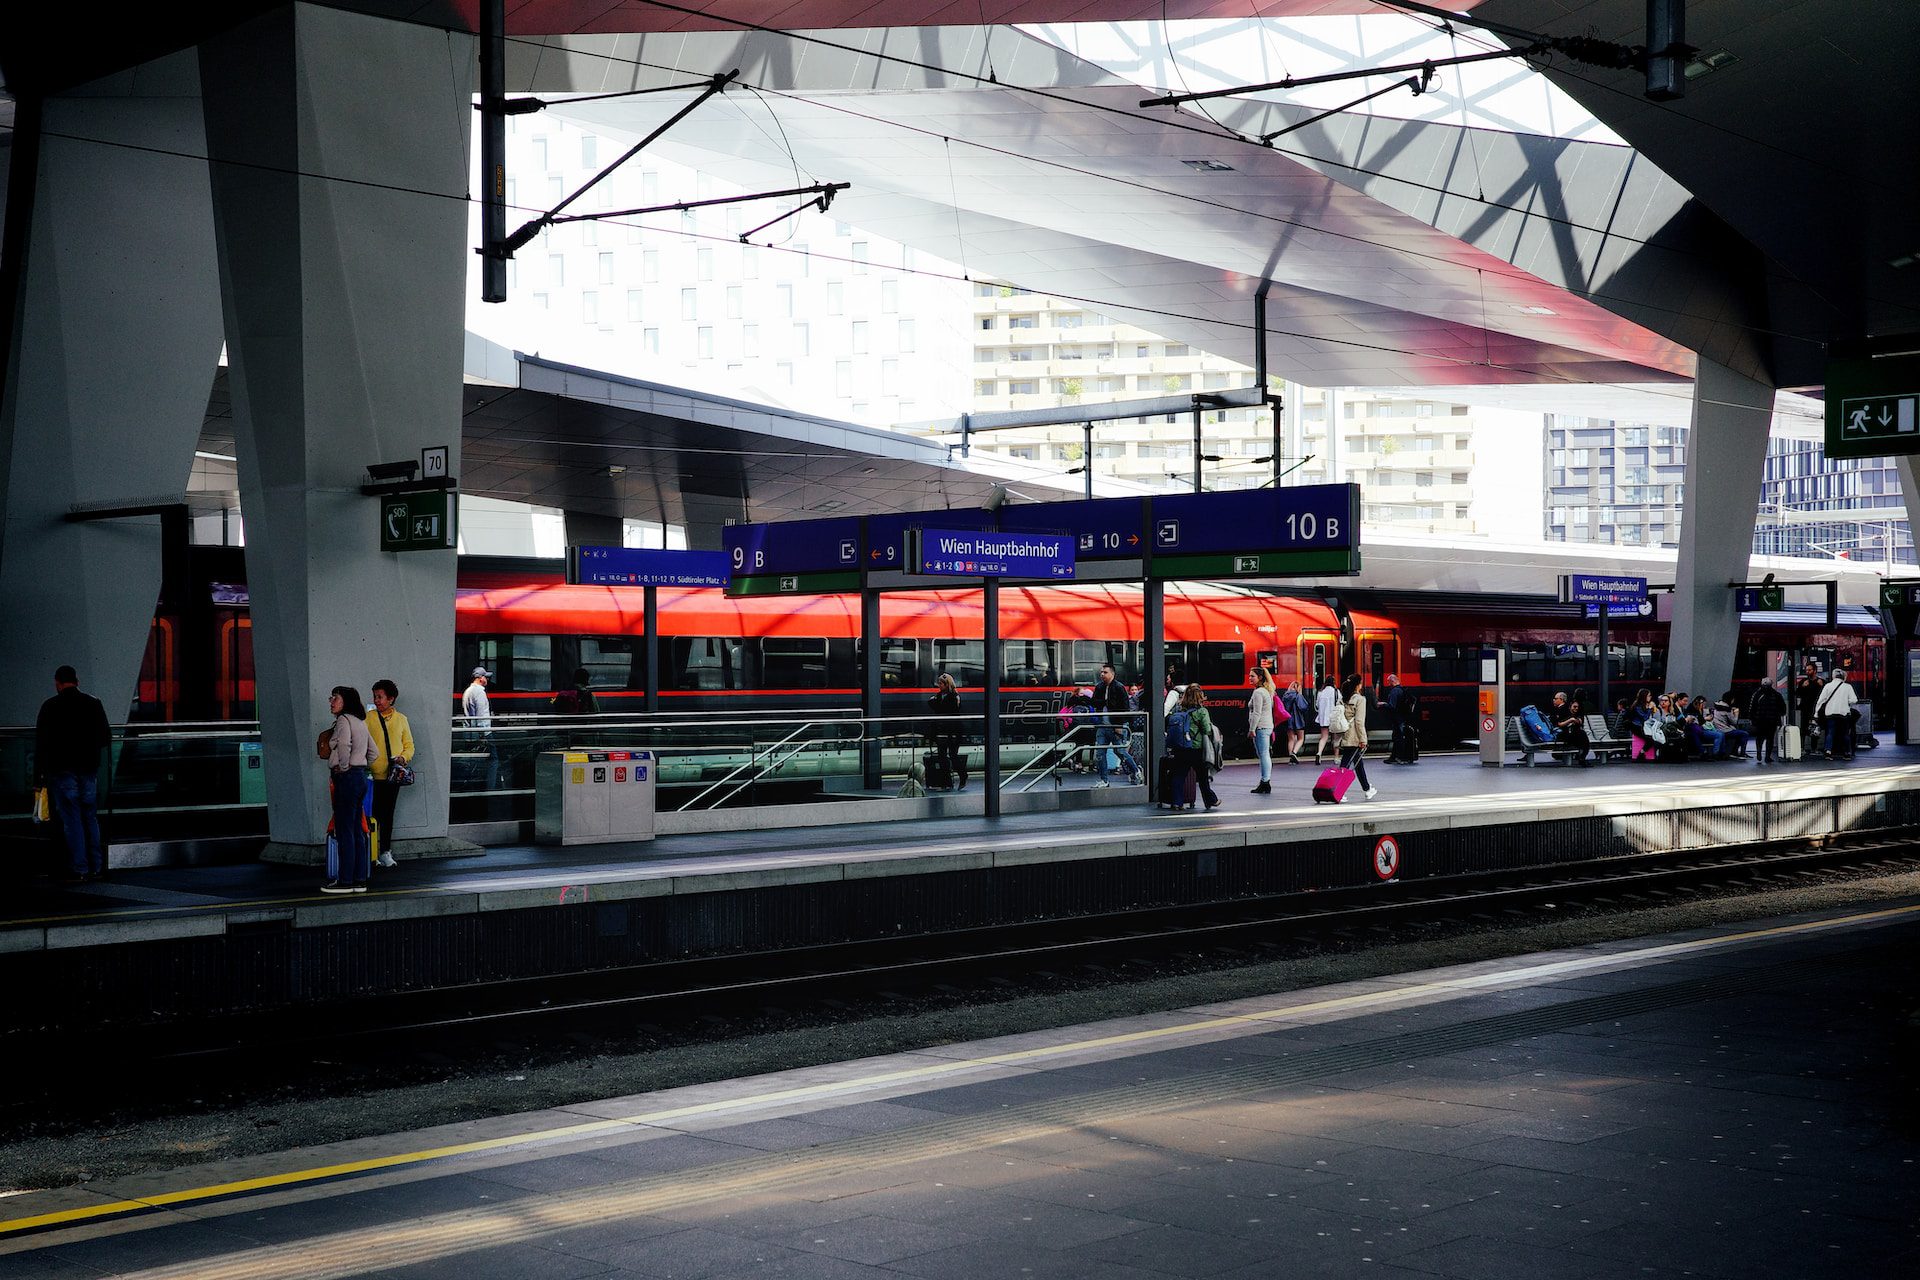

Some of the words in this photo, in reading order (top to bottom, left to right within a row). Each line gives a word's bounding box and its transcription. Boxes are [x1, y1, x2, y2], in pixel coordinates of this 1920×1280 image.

[428, 456, 442, 470] 70
[394, 507, 406, 517] SOS
[1286, 512, 1317, 541] 10
[1326, 518, 1340, 539] B
[1102, 533, 1120, 549] 10
[887, 546, 895, 561] 9
[940, 538, 972, 555] Wien
[975, 540, 1060, 560] Hauptbahnhof
[733, 547, 744, 570] 9
[755, 550, 764, 568] B
[942, 561, 953, 571] 1-2
[651, 574, 668, 583] 11-12
[677, 576, 705, 585] Südtiroler
[706, 576, 720, 585] Platz
[1582, 579, 1598, 590] Wien
[1599, 580, 1639, 593] Hauptbahnhof
[1316, 653, 1323, 664] 2
[1373, 653, 1382, 664] 2
[1202, 699, 1246, 709] economy
